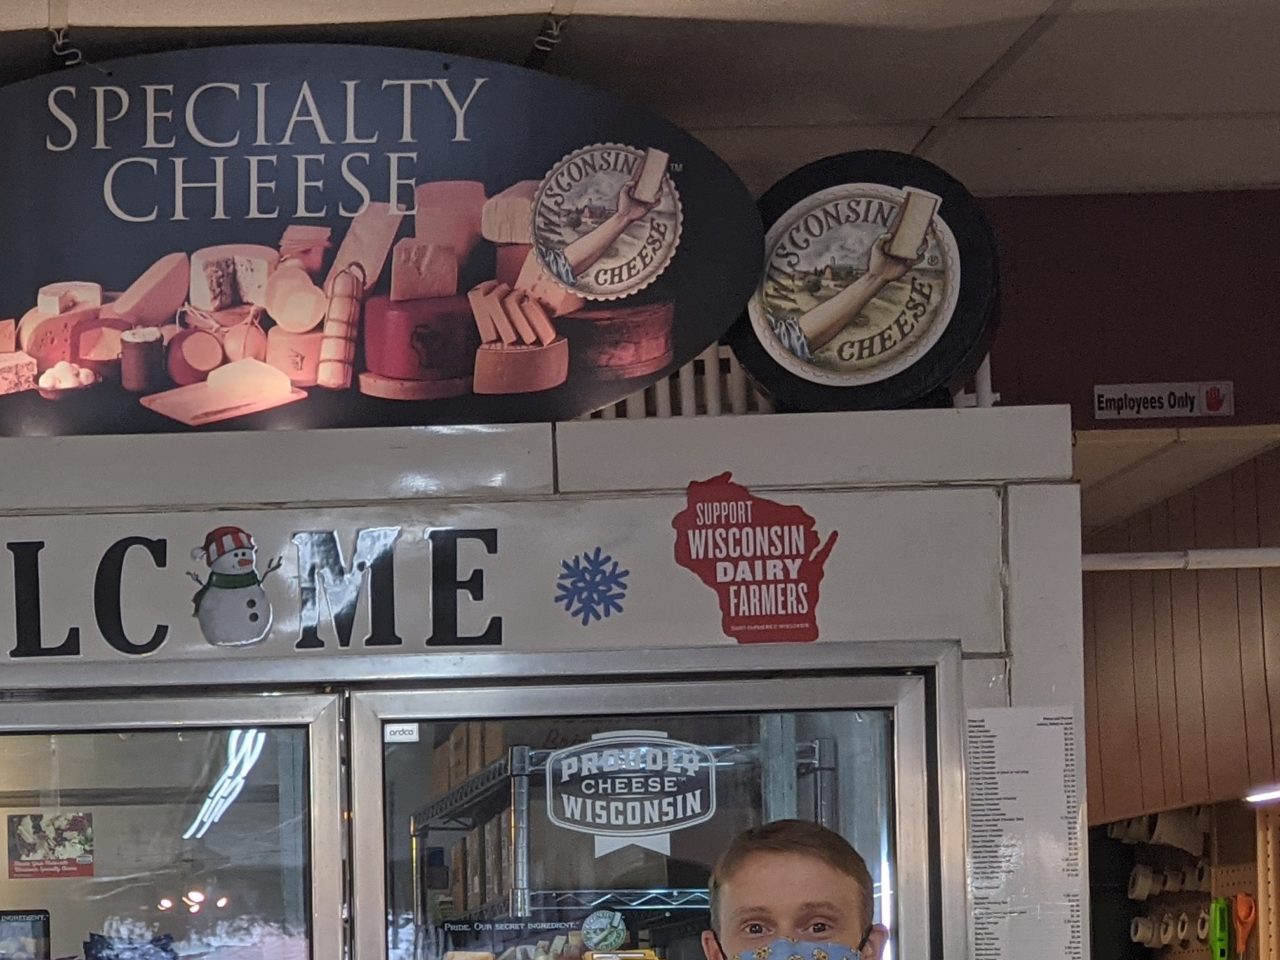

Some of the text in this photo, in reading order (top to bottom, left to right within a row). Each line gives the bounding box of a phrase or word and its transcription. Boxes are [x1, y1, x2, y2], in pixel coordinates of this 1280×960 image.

[45, 76, 490, 152] SPECIALTY
[103, 152, 419, 223] CHEESE
[536, 149, 642, 238] WISCONSIN
[593, 218, 668, 286] CHEESE
[763, 198, 898, 304] WISCONSIN
[836, 277, 934, 362] CHEESE
[1096, 391, 1196, 415] Employees Only
[696, 500, 753, 525] SUPPORT
[687, 525, 805, 559] WISCONSIN
[716, 558, 803, 582] DAIRY
[729, 582, 809, 617] FARMERS
[389, 727, 414, 736] ardco
[560, 747, 702, 783] PROUDLY
[581, 777, 678, 794] CHEESE
[560, 789, 703, 826] WISCONSIN
